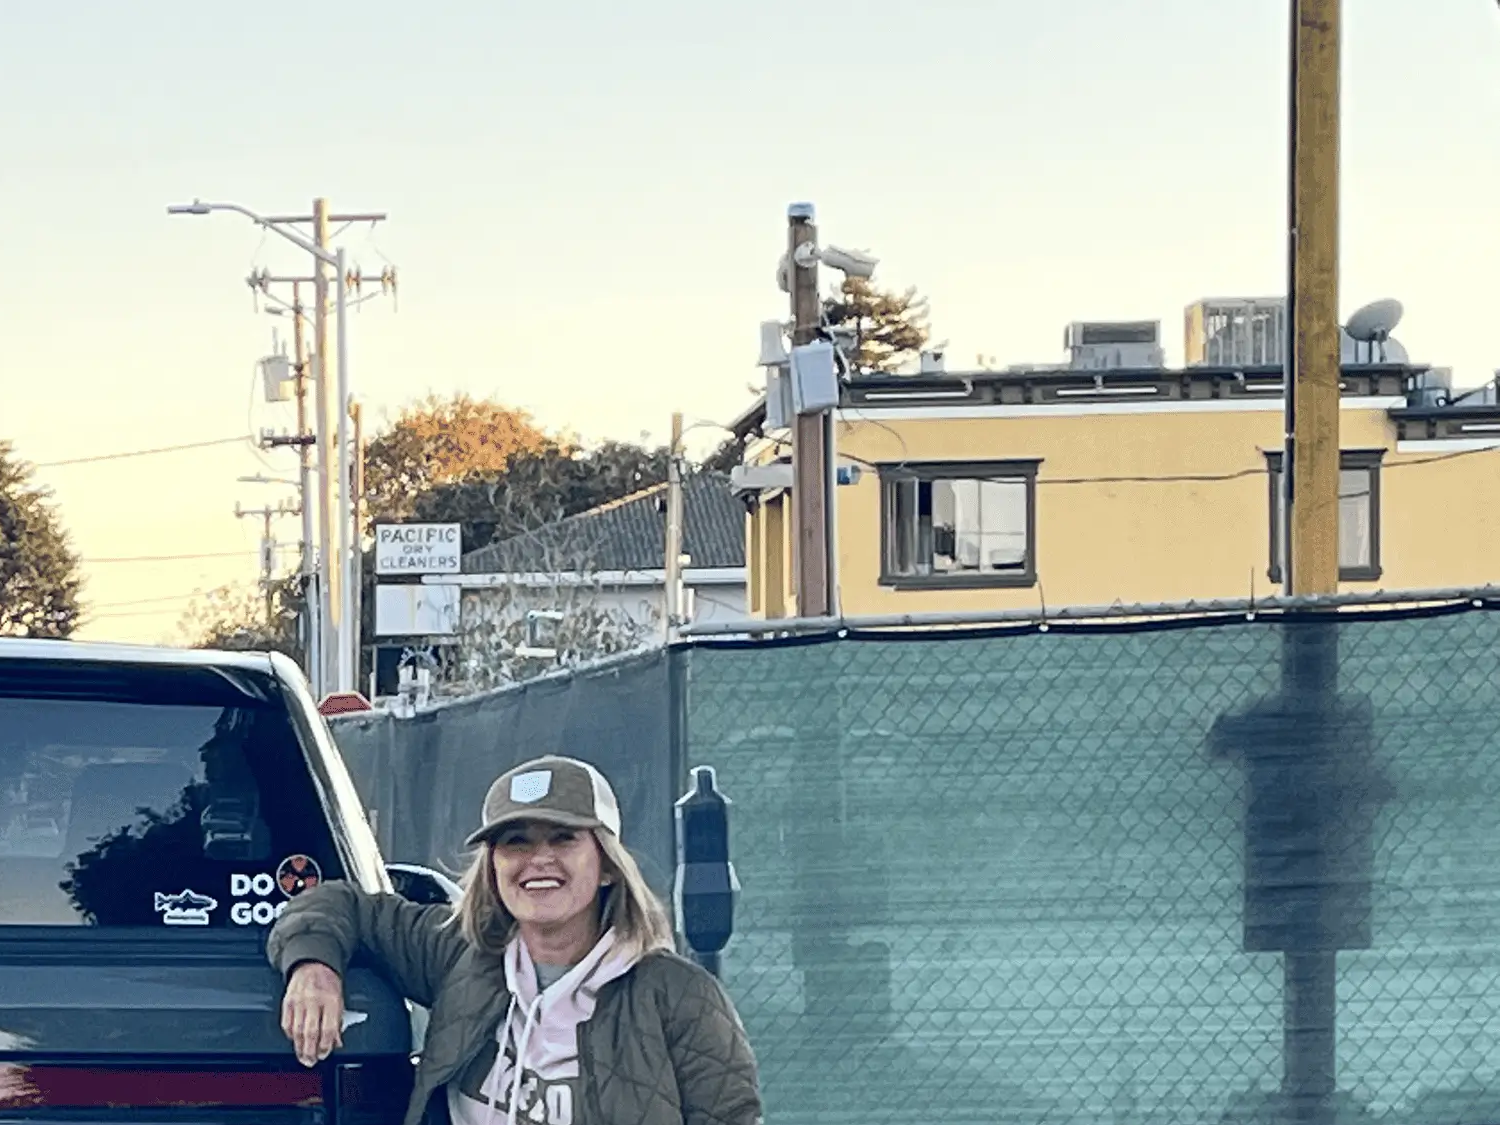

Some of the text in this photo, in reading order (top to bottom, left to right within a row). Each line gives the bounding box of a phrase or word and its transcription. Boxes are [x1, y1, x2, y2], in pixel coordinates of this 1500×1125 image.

[380, 528, 457, 543] PACIFIC
[402, 544, 433, 555] DRY
[380, 556, 457, 569] CLEANERS
[231, 873, 275, 897] DO
